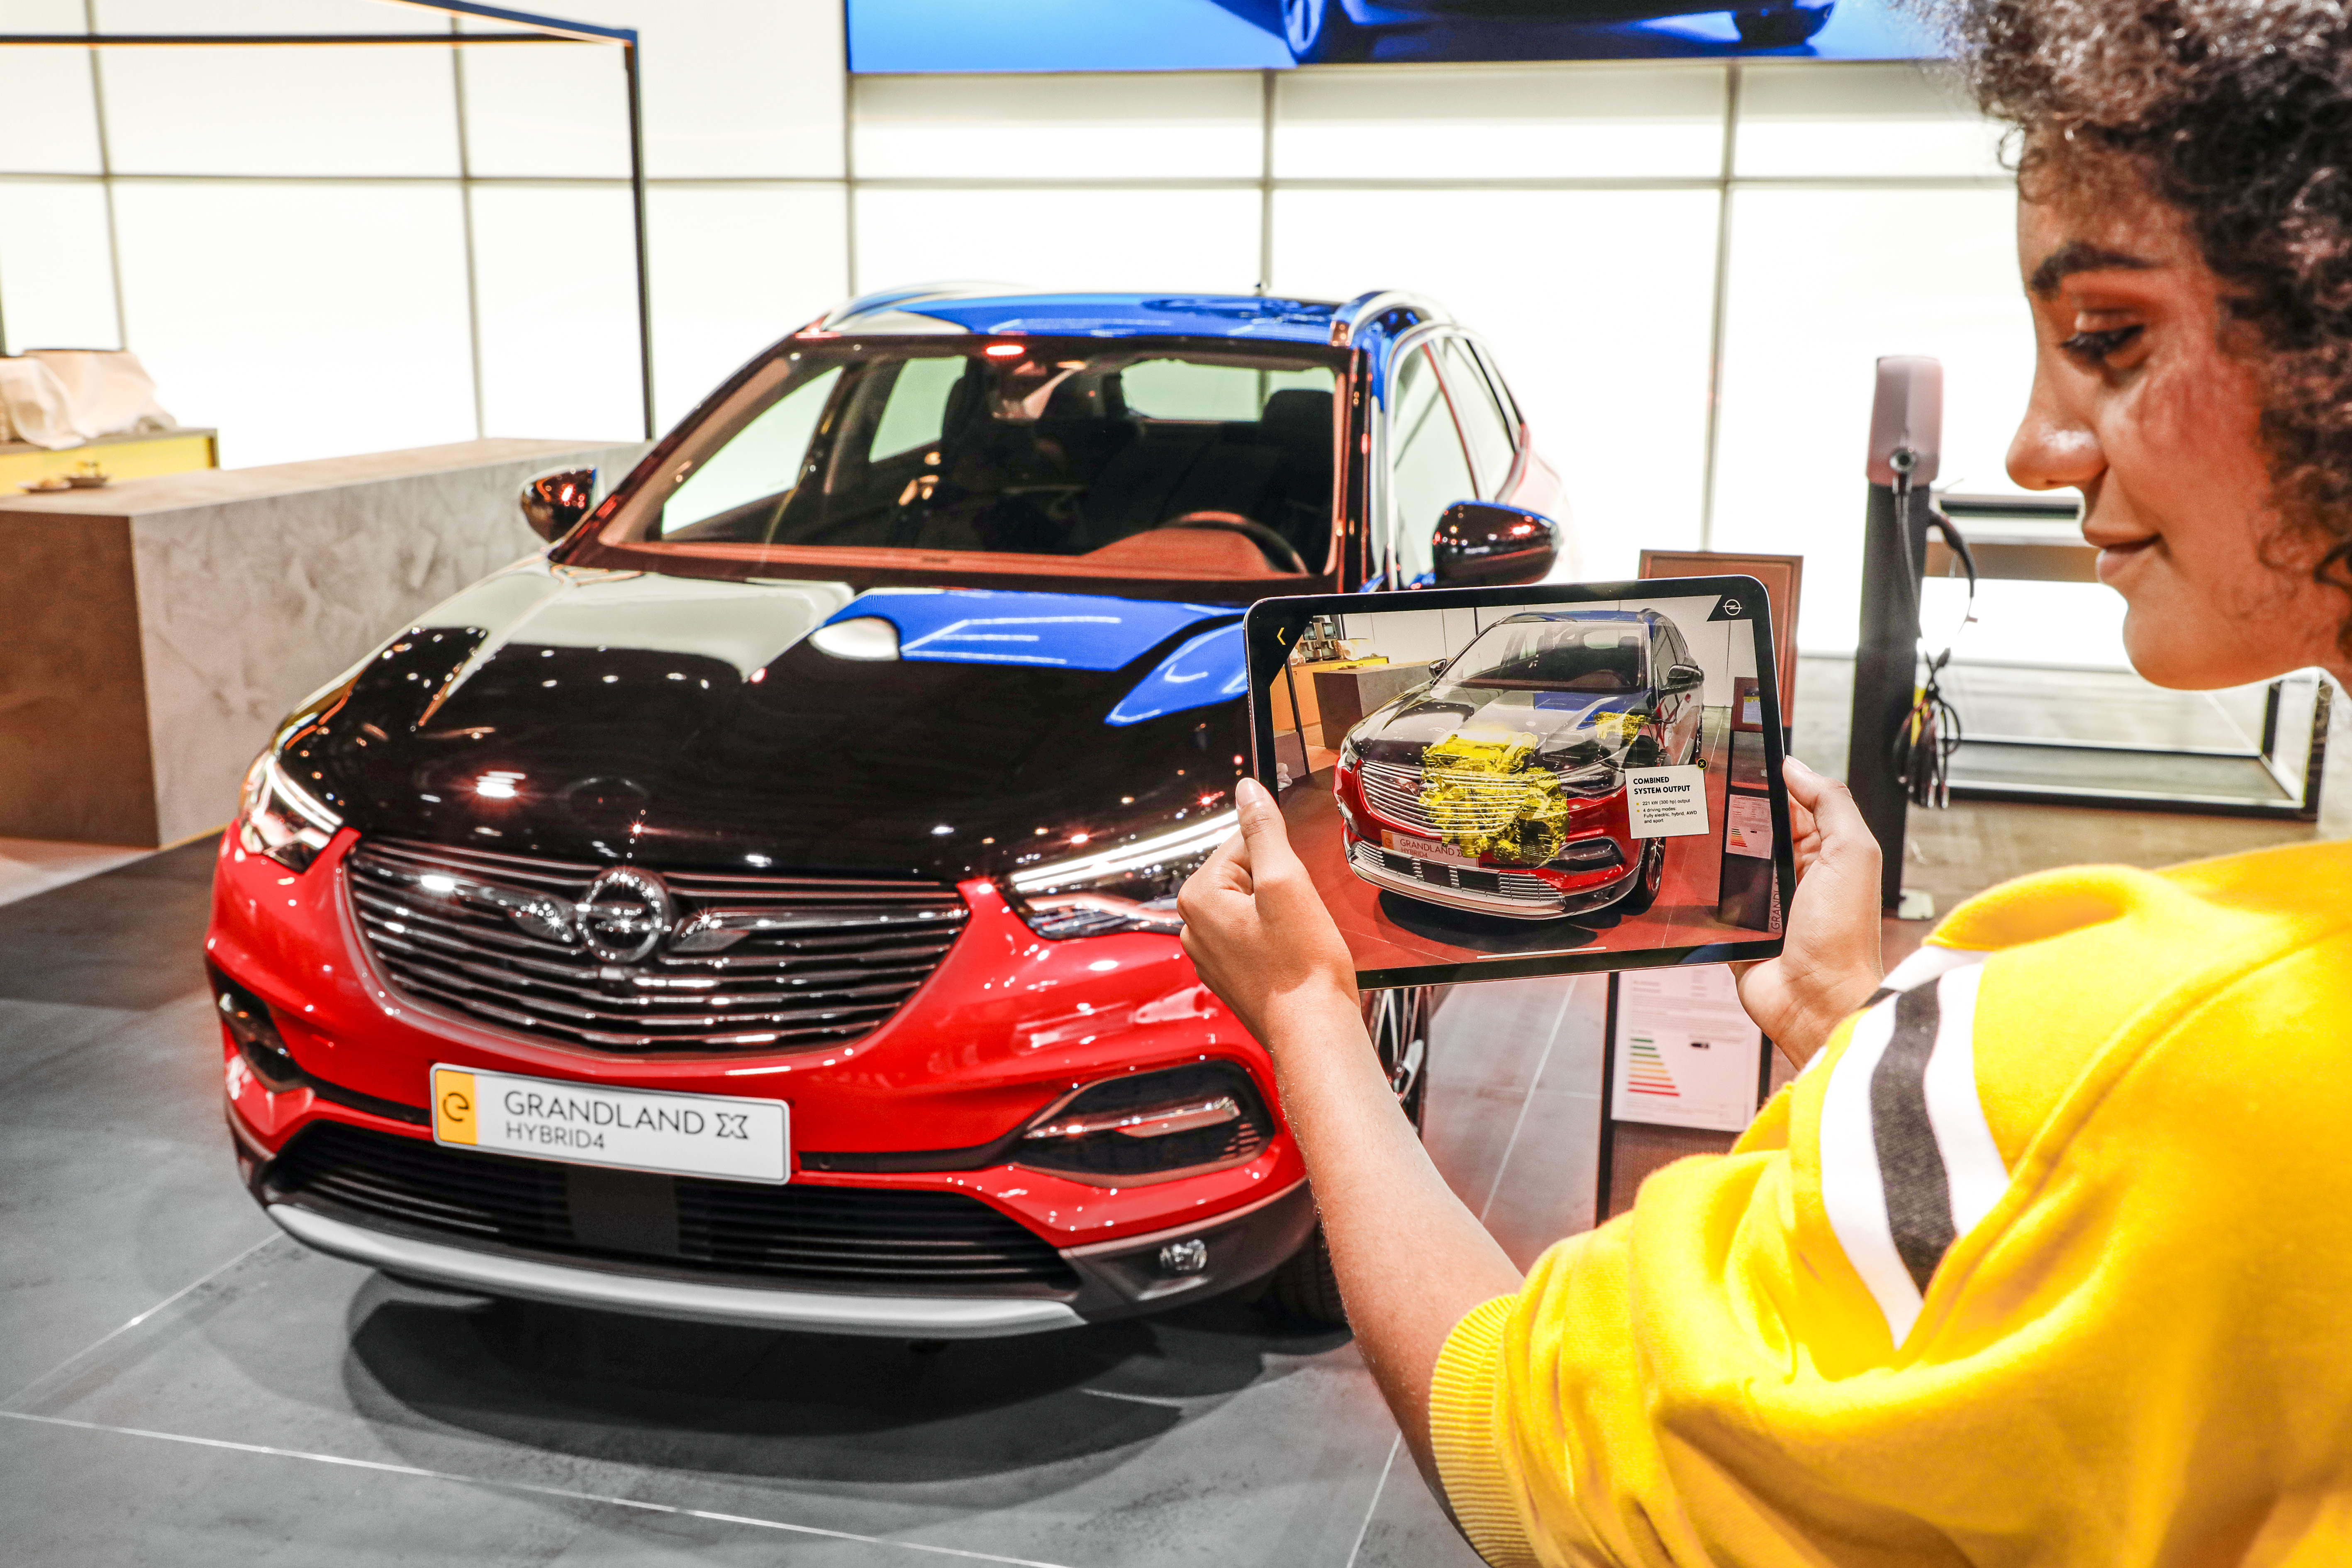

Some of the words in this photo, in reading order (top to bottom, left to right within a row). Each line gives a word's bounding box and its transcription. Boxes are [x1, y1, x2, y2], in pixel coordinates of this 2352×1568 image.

[1400, 839, 1455, 856] GRANDLAND
[1401, 847, 1428, 858] HYBRID4
[504, 1090, 705, 1134] GRANDLAND
[715, 1112, 749, 1140] X
[506, 1121, 605, 1151] HYBRID4
